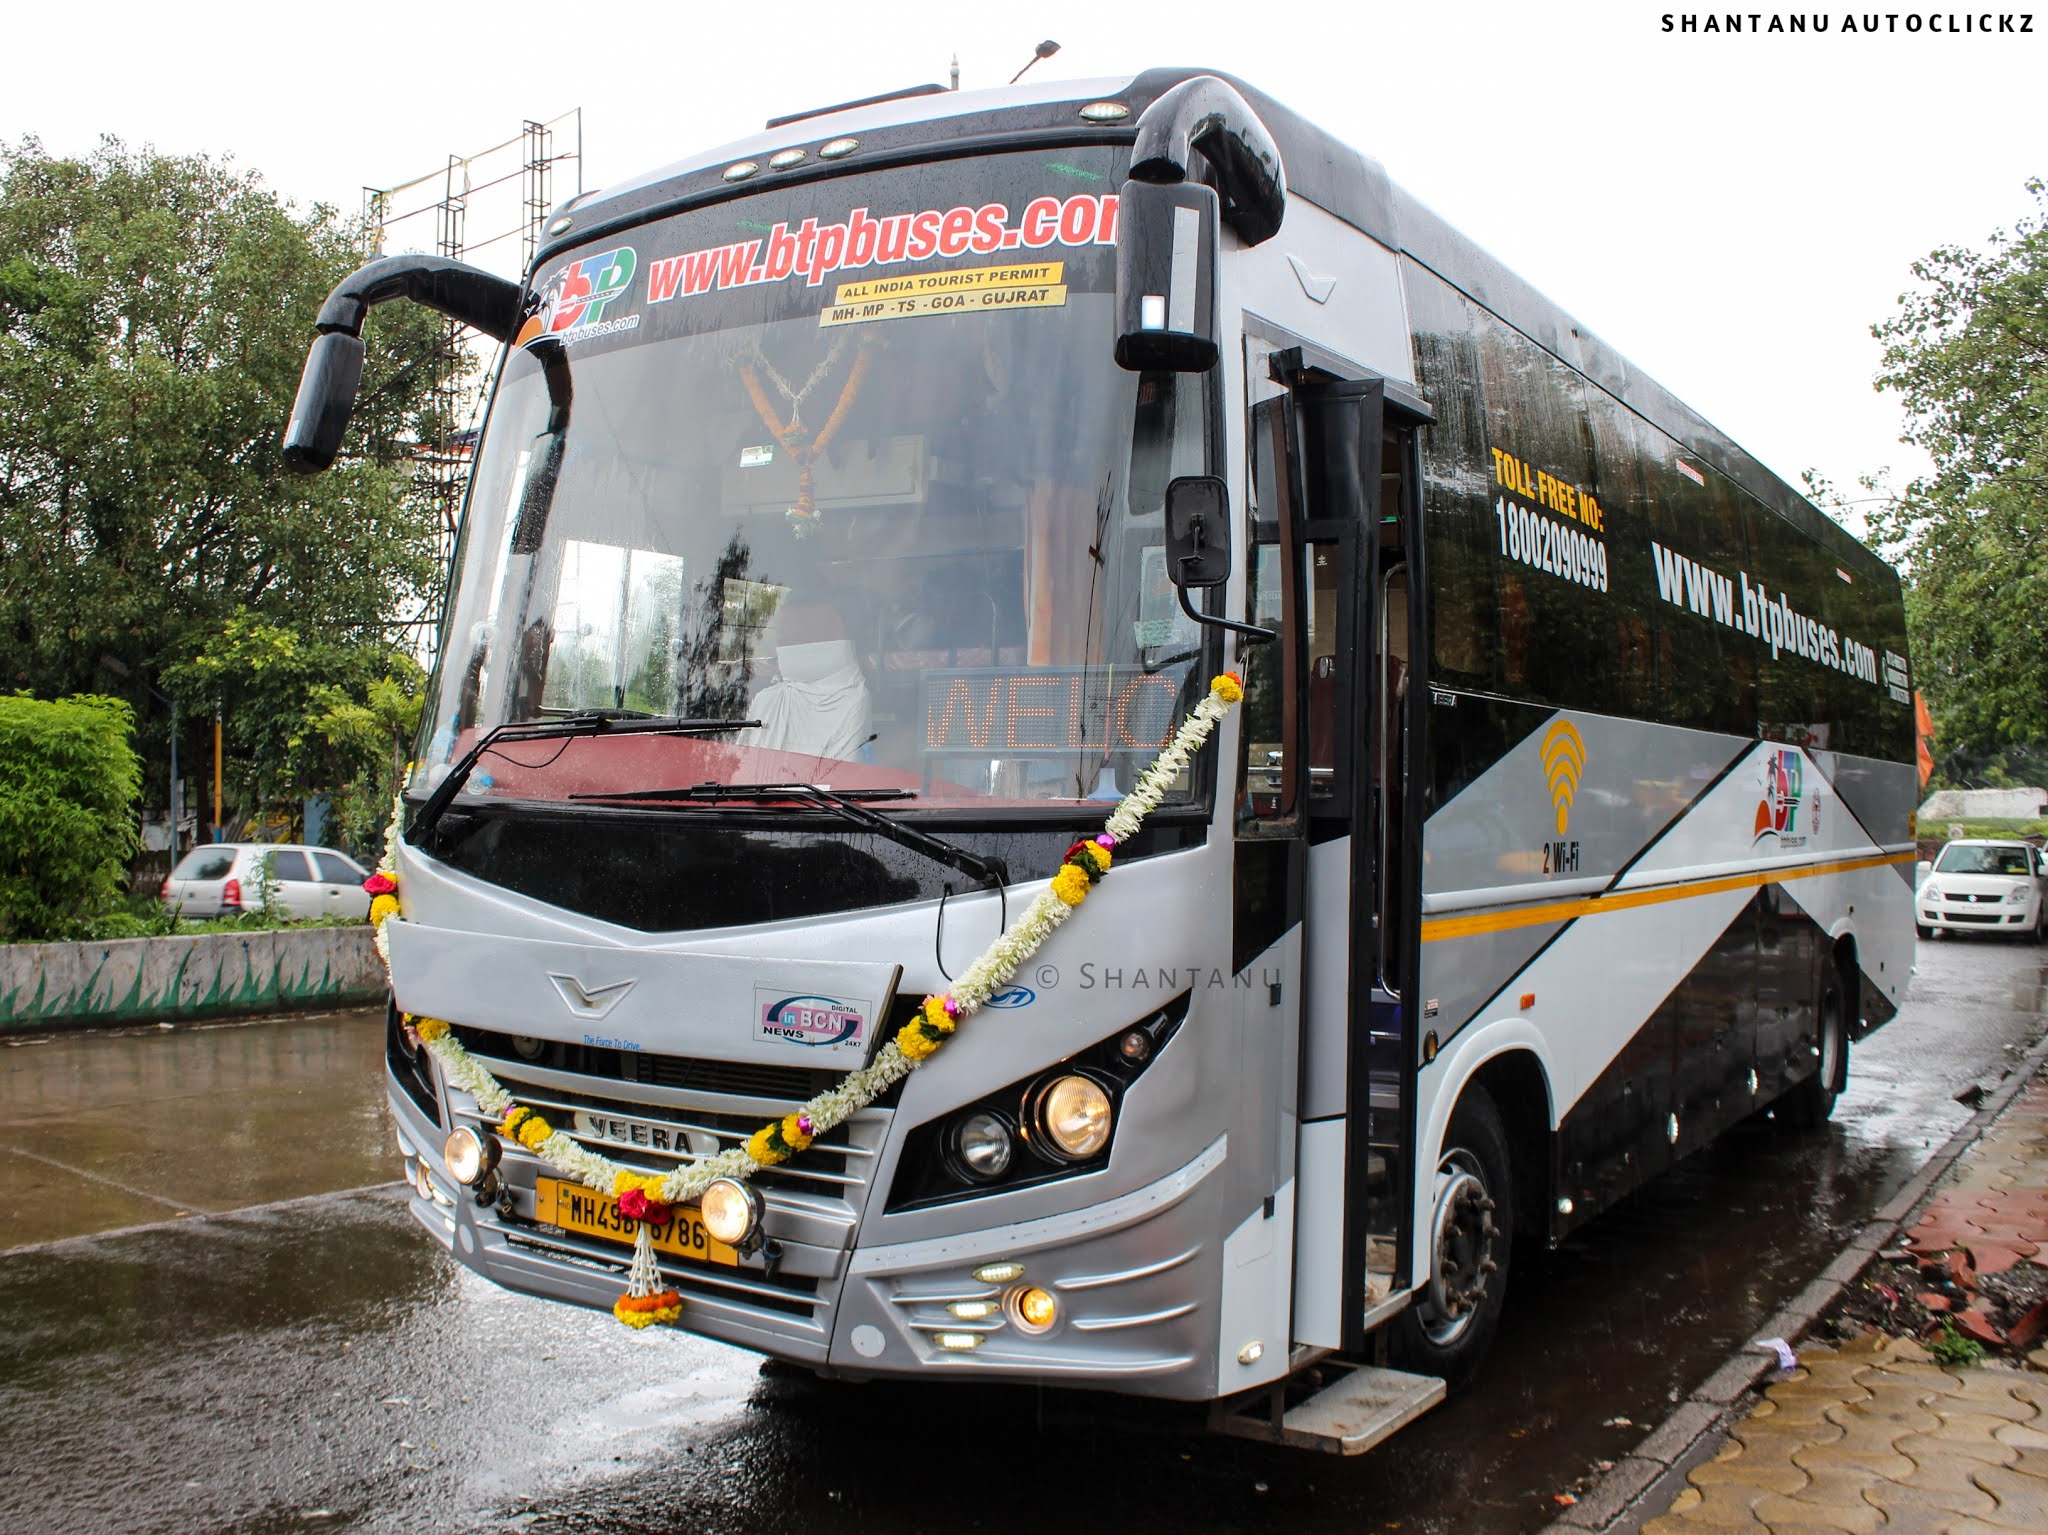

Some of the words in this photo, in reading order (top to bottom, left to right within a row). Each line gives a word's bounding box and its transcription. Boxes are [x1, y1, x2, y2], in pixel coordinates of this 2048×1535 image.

[843, 286, 869, 298] ALL
[874, 280, 913, 294] INDIA
[918, 273, 984, 289] TOURIST
[989, 267, 1050, 282] PERMIT
[982, 289, 1050, 305] GUJRAT
[559, 314, 640, 346] btpbuses.com
[1491, 446, 1536, 500] TOLL
[1537, 470, 1577, 520] FREE
[1579, 491, 1604, 533] NO:
[1496, 495, 1608, 593] 18002090999
[1651, 540, 1878, 685] www.btpbuses.com
[1543, 842, 1550, 874] 2
[1553, 841, 1579, 873] Wi-Fi
[800, 1009, 844, 1031] BCN
[831, 1005, 858, 1014] DIGITAL
[583, 1034, 595, 1046] The
[596, 1036, 613, 1048] Force
[614, 1038, 622, 1049] To
[763, 1026, 804, 1039] NEWS
[844, 1040, 861, 1048] 24X7
[588, 1115, 694, 1154] VEERA
